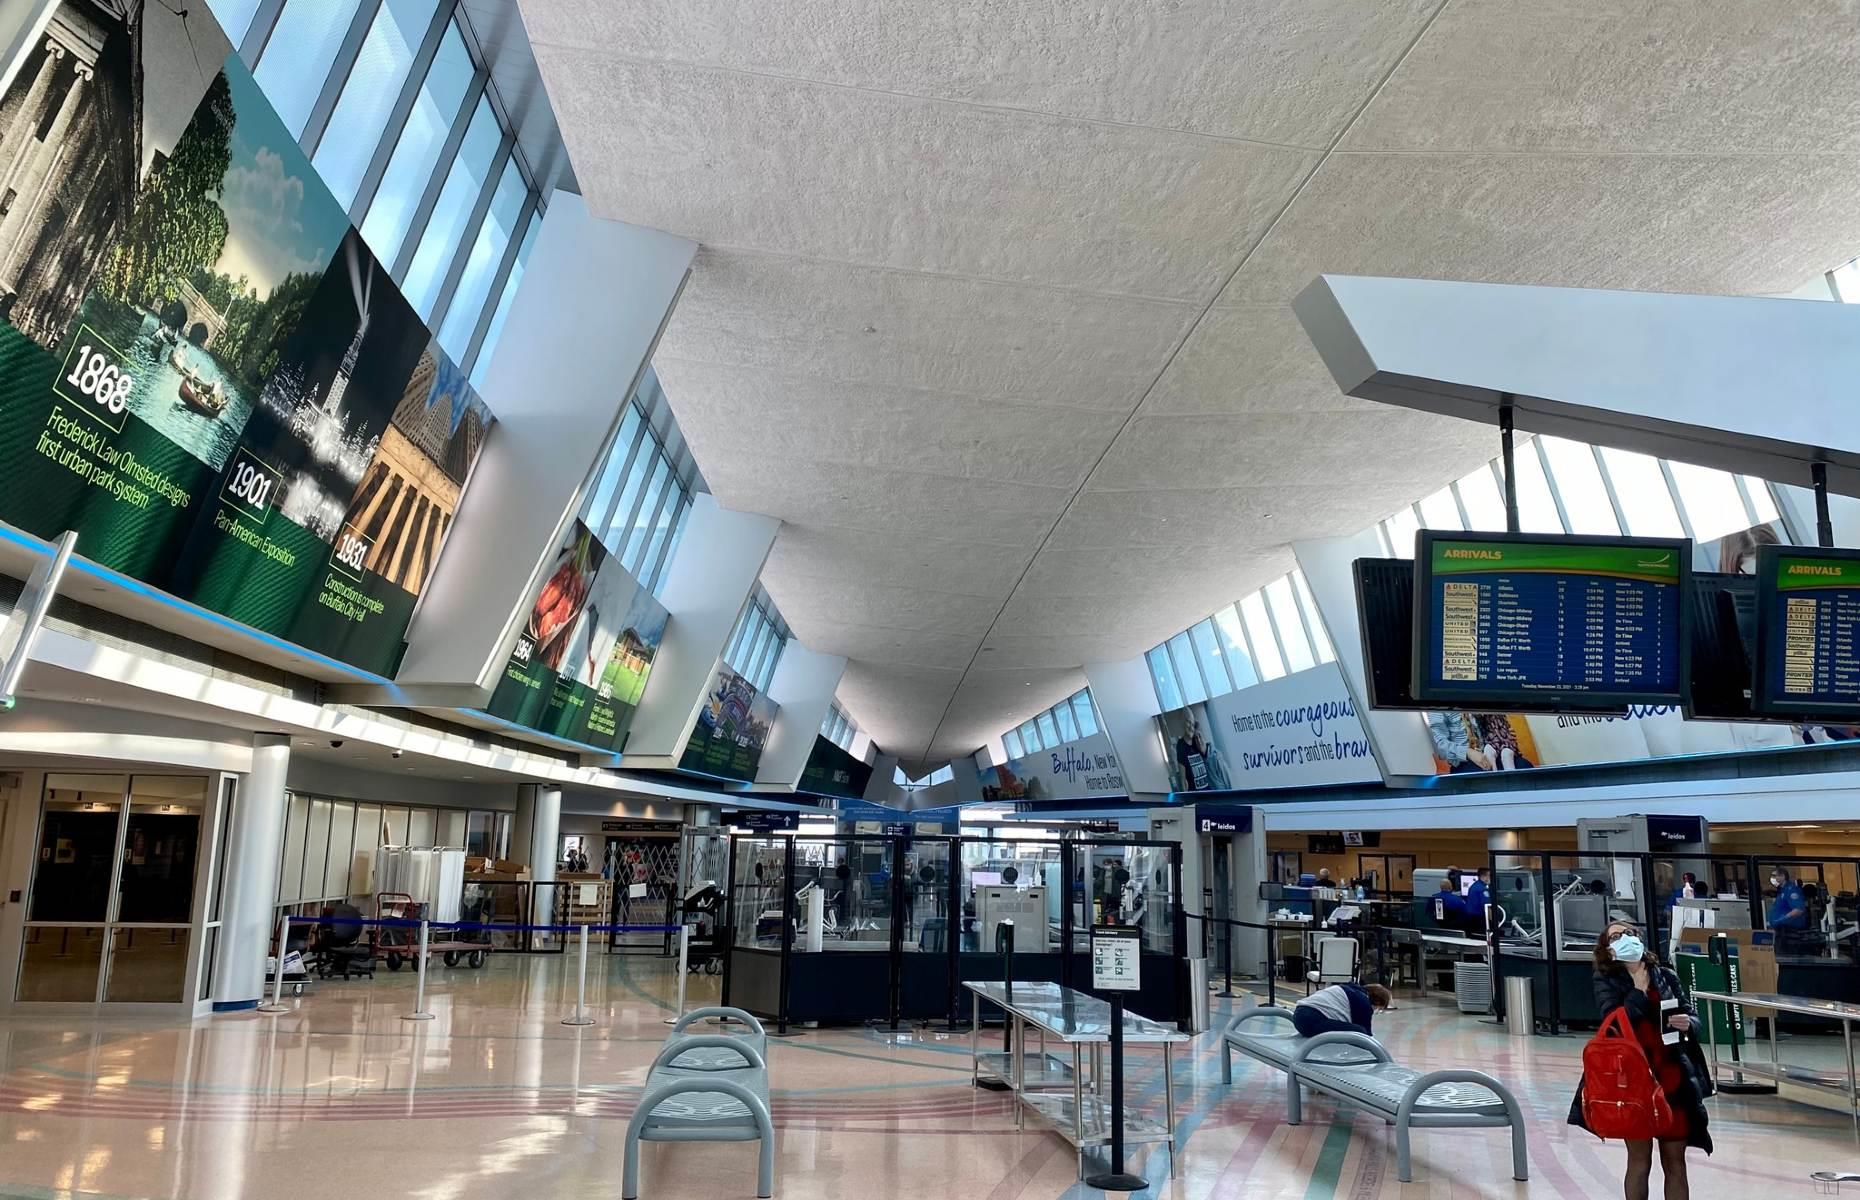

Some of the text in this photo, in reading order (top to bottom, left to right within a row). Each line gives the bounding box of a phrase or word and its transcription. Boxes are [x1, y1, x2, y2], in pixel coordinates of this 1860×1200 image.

[66, 345, 133, 414] 1868
[35, 430, 150, 509] first urban park system
[46, 406, 191, 508] Frederick Law Olmsted designs
[228, 461, 272, 511] 1901
[213, 509, 296, 568] Pan-American Exposition
[335, 533, 368, 571] 1931
[1444, 549, 1502, 560] ARRIVALS
[1788, 565, 1842, 576] ARRIVALS
[318, 592, 366, 622] on Buffalo City Hall
[324, 572, 359, 601] Construction
[362, 594, 385, 614] complete
[513, 639, 533, 662] 1964
[1231, 698, 1355, 737] Home to the courageous
[1051, 747, 1118, 784] Buffalo, New Yo
[1243, 745, 1304, 771] survivors
[1304, 740, 1321, 762] and
[1320, 739, 1335, 761] the
[1084, 775, 1103, 790] Home
[1101, 776, 1109, 790] to
[1667, 832, 1686, 840] leidos
